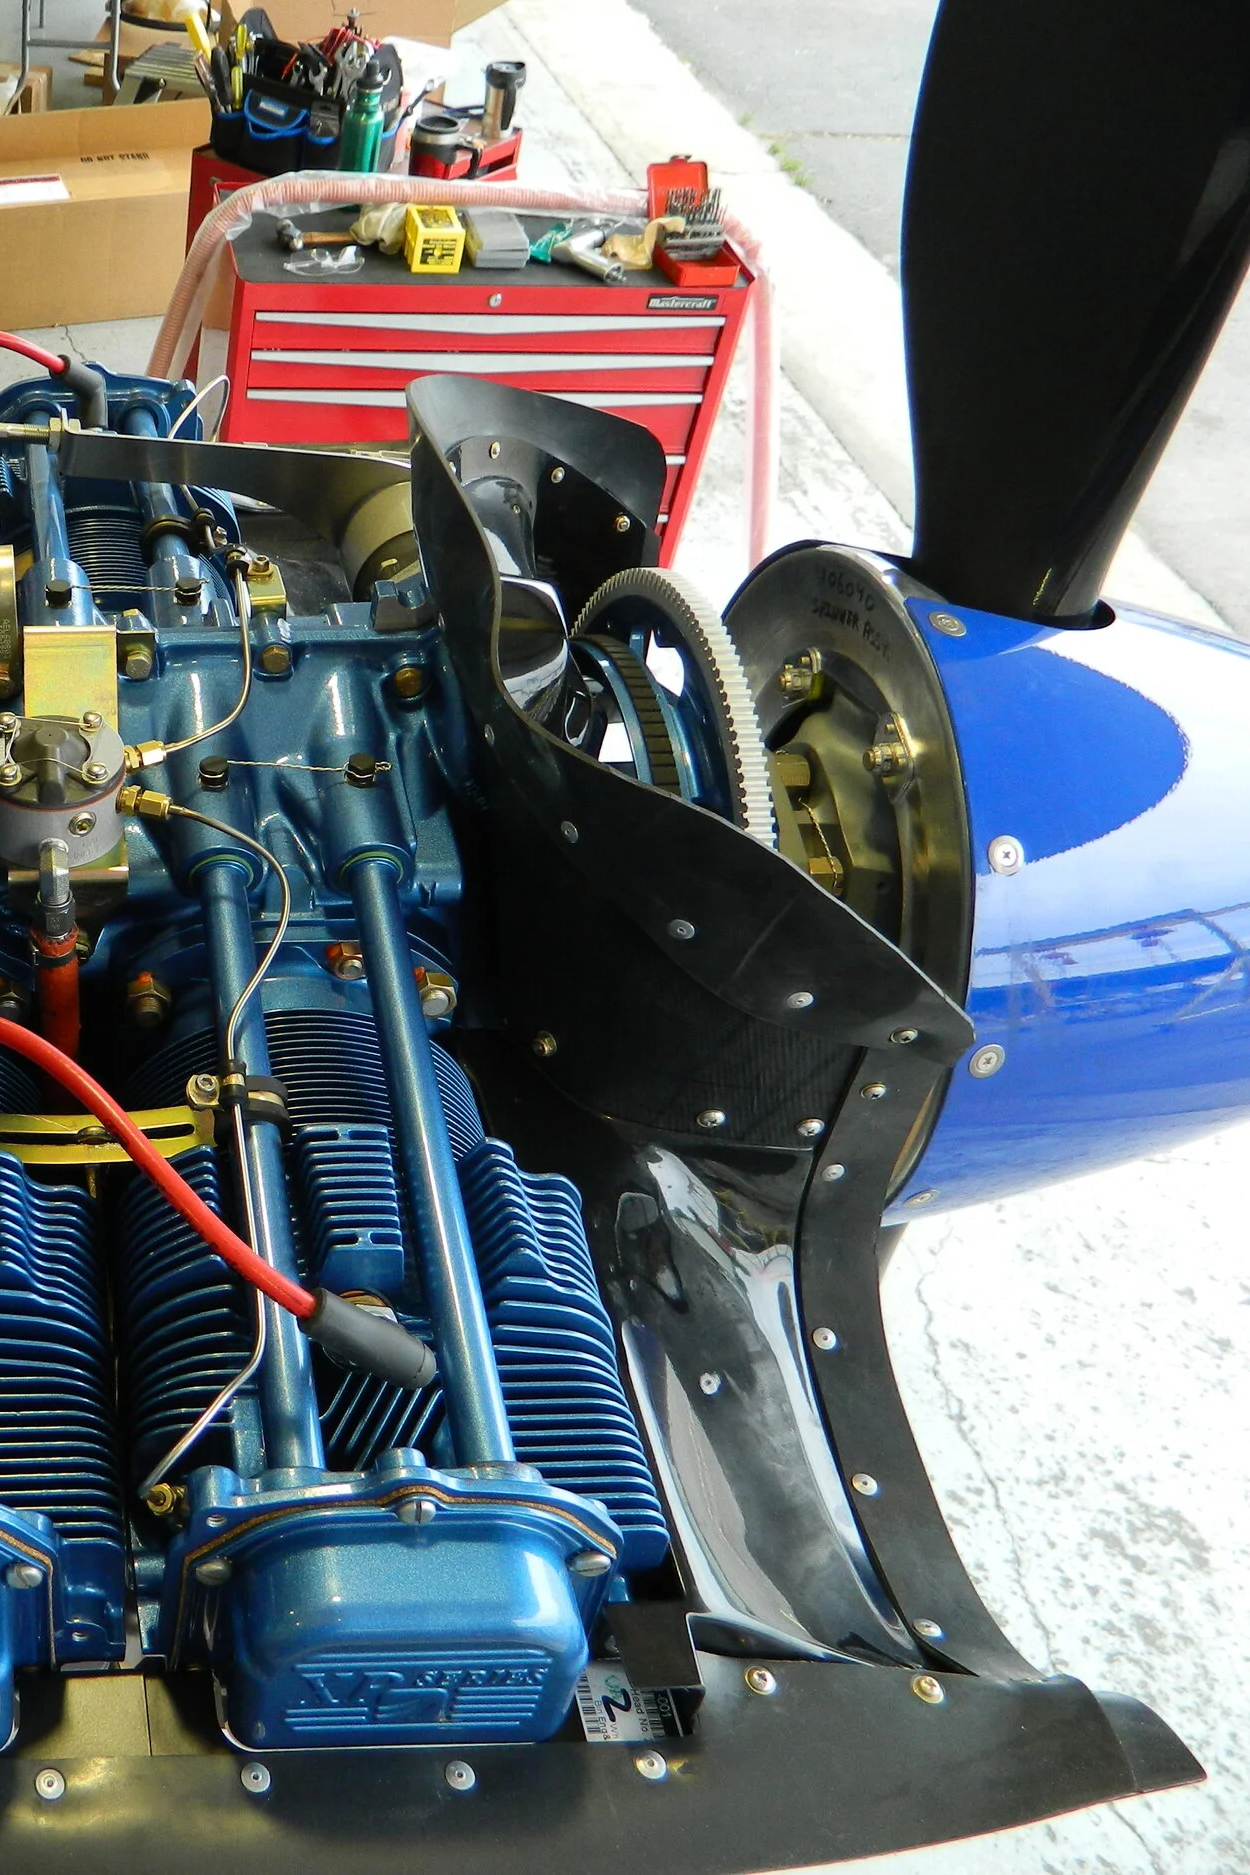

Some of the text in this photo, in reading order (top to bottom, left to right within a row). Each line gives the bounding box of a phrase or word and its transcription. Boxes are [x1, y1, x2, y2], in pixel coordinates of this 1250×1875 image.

[648, 297, 717, 309] Mastercraft
[413, 1667, 549, 1688] SERIES
[601, 1688, 632, 1722] 2
[631, 1688, 645, 1715] Head
